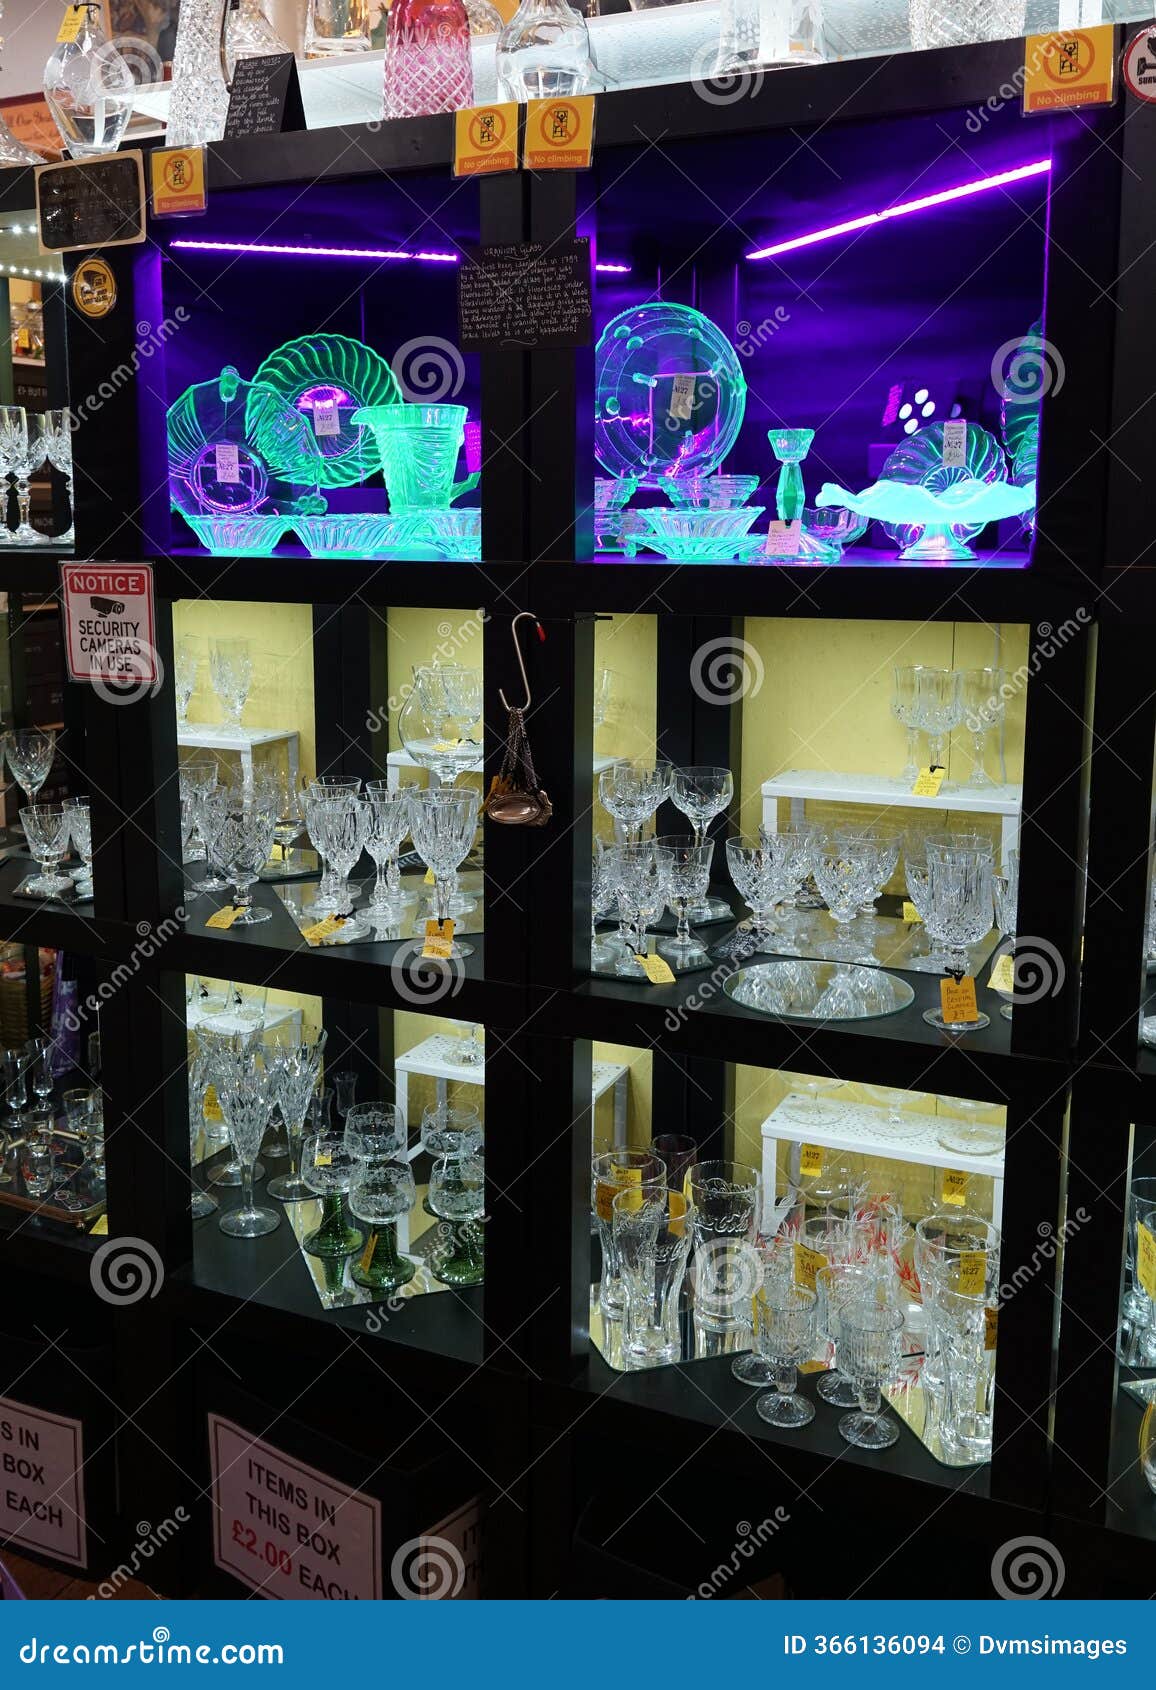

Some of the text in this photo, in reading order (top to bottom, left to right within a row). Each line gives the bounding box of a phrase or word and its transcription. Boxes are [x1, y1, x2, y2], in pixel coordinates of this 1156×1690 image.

[1037, 90, 1100, 105] No climbing
[477, 156, 509, 166] climbing
[547, 154, 582, 162] climbing
[73, 575, 140, 592] NOTICE
[79, 620, 140, 637] SECURITY
[80, 637, 141, 655] CAMERAS
[90, 655, 133, 672] IN USE
[19, 1426, 40, 1451] IN
[3, 1453, 45, 1485] BOX
[248, 1459, 336, 1527] ITEMS IN
[6, 1490, 63, 1528] EACH
[245, 1492, 342, 1566] THIS BOX
[232, 1519, 292, 1577] £2.00
